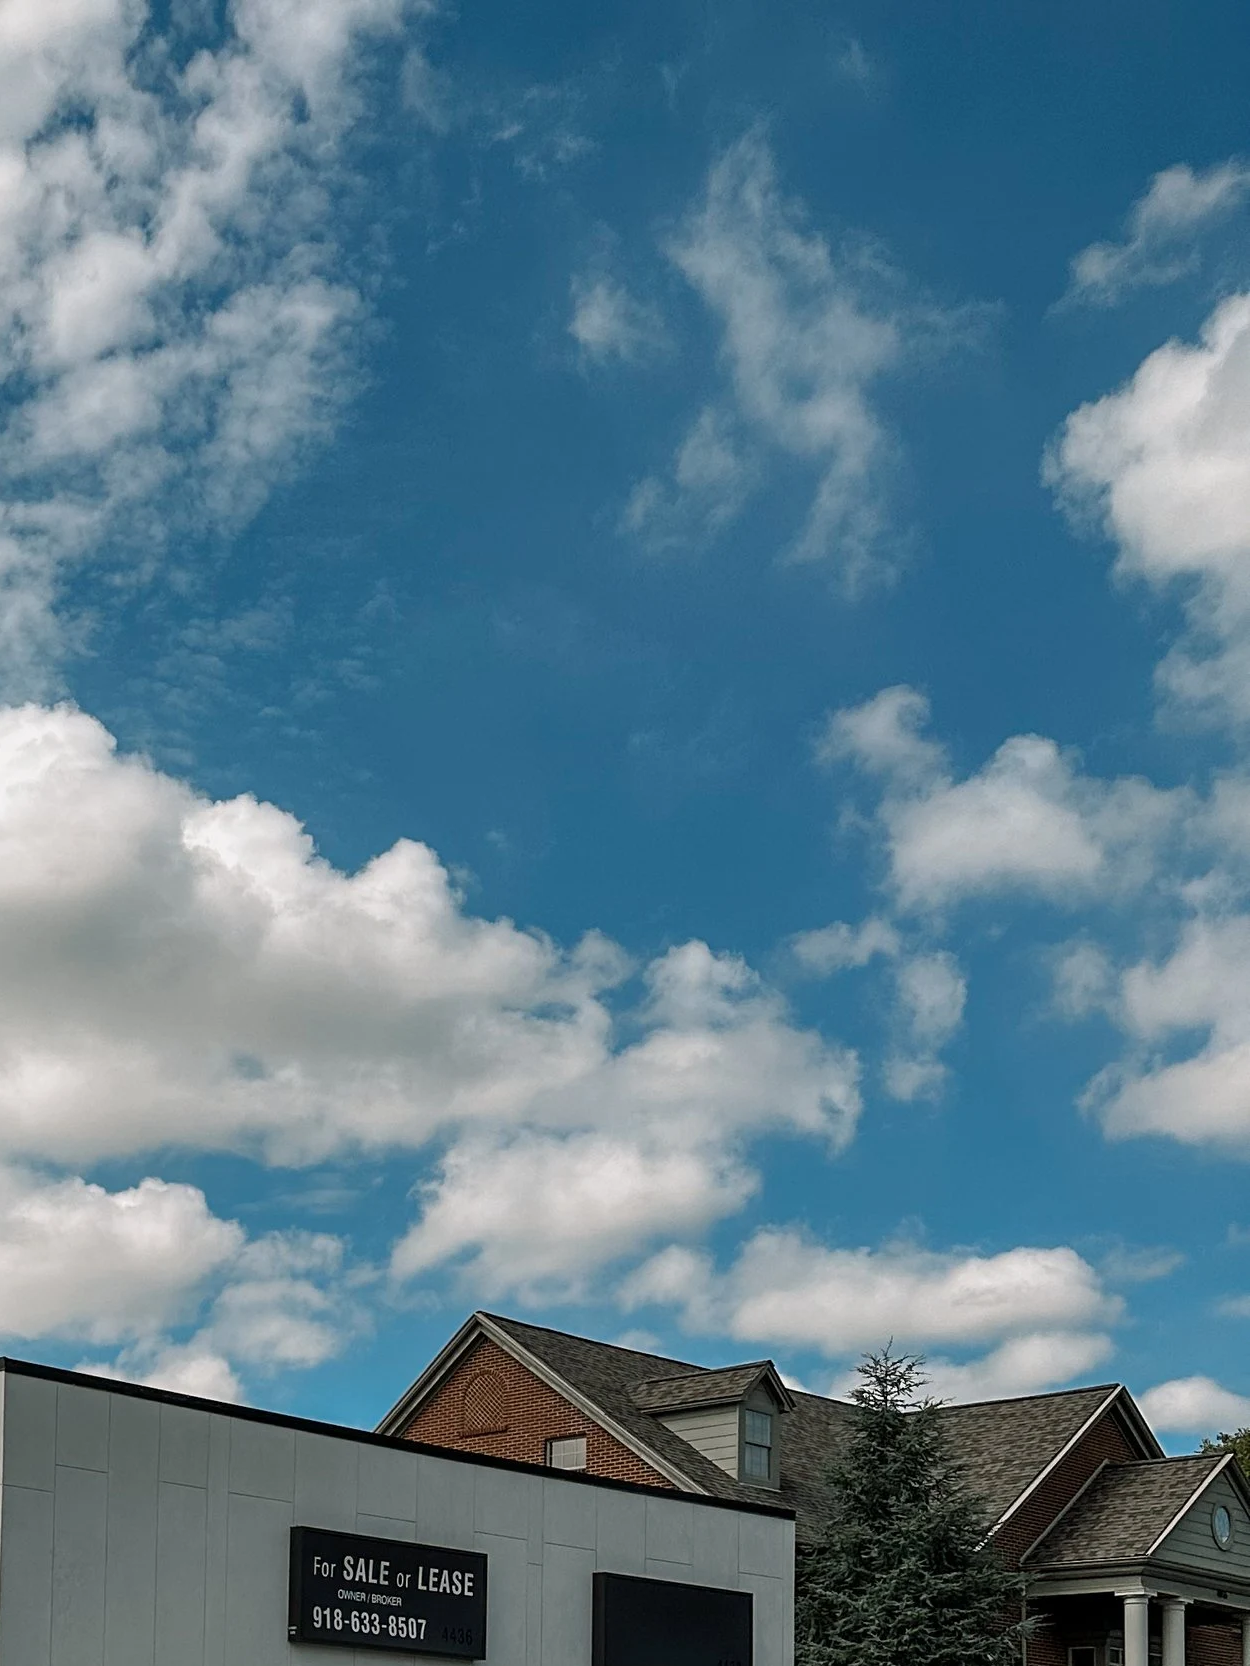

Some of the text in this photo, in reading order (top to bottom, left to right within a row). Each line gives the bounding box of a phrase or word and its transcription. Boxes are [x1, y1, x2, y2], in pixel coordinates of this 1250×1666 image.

[313, 1555, 475, 1597] For SALE or LEASE
[337, 1588, 366, 1602] OWNER
[371, 1593, 402, 1607] BROKER
[312, 1605, 427, 1640] 918-633-8507
